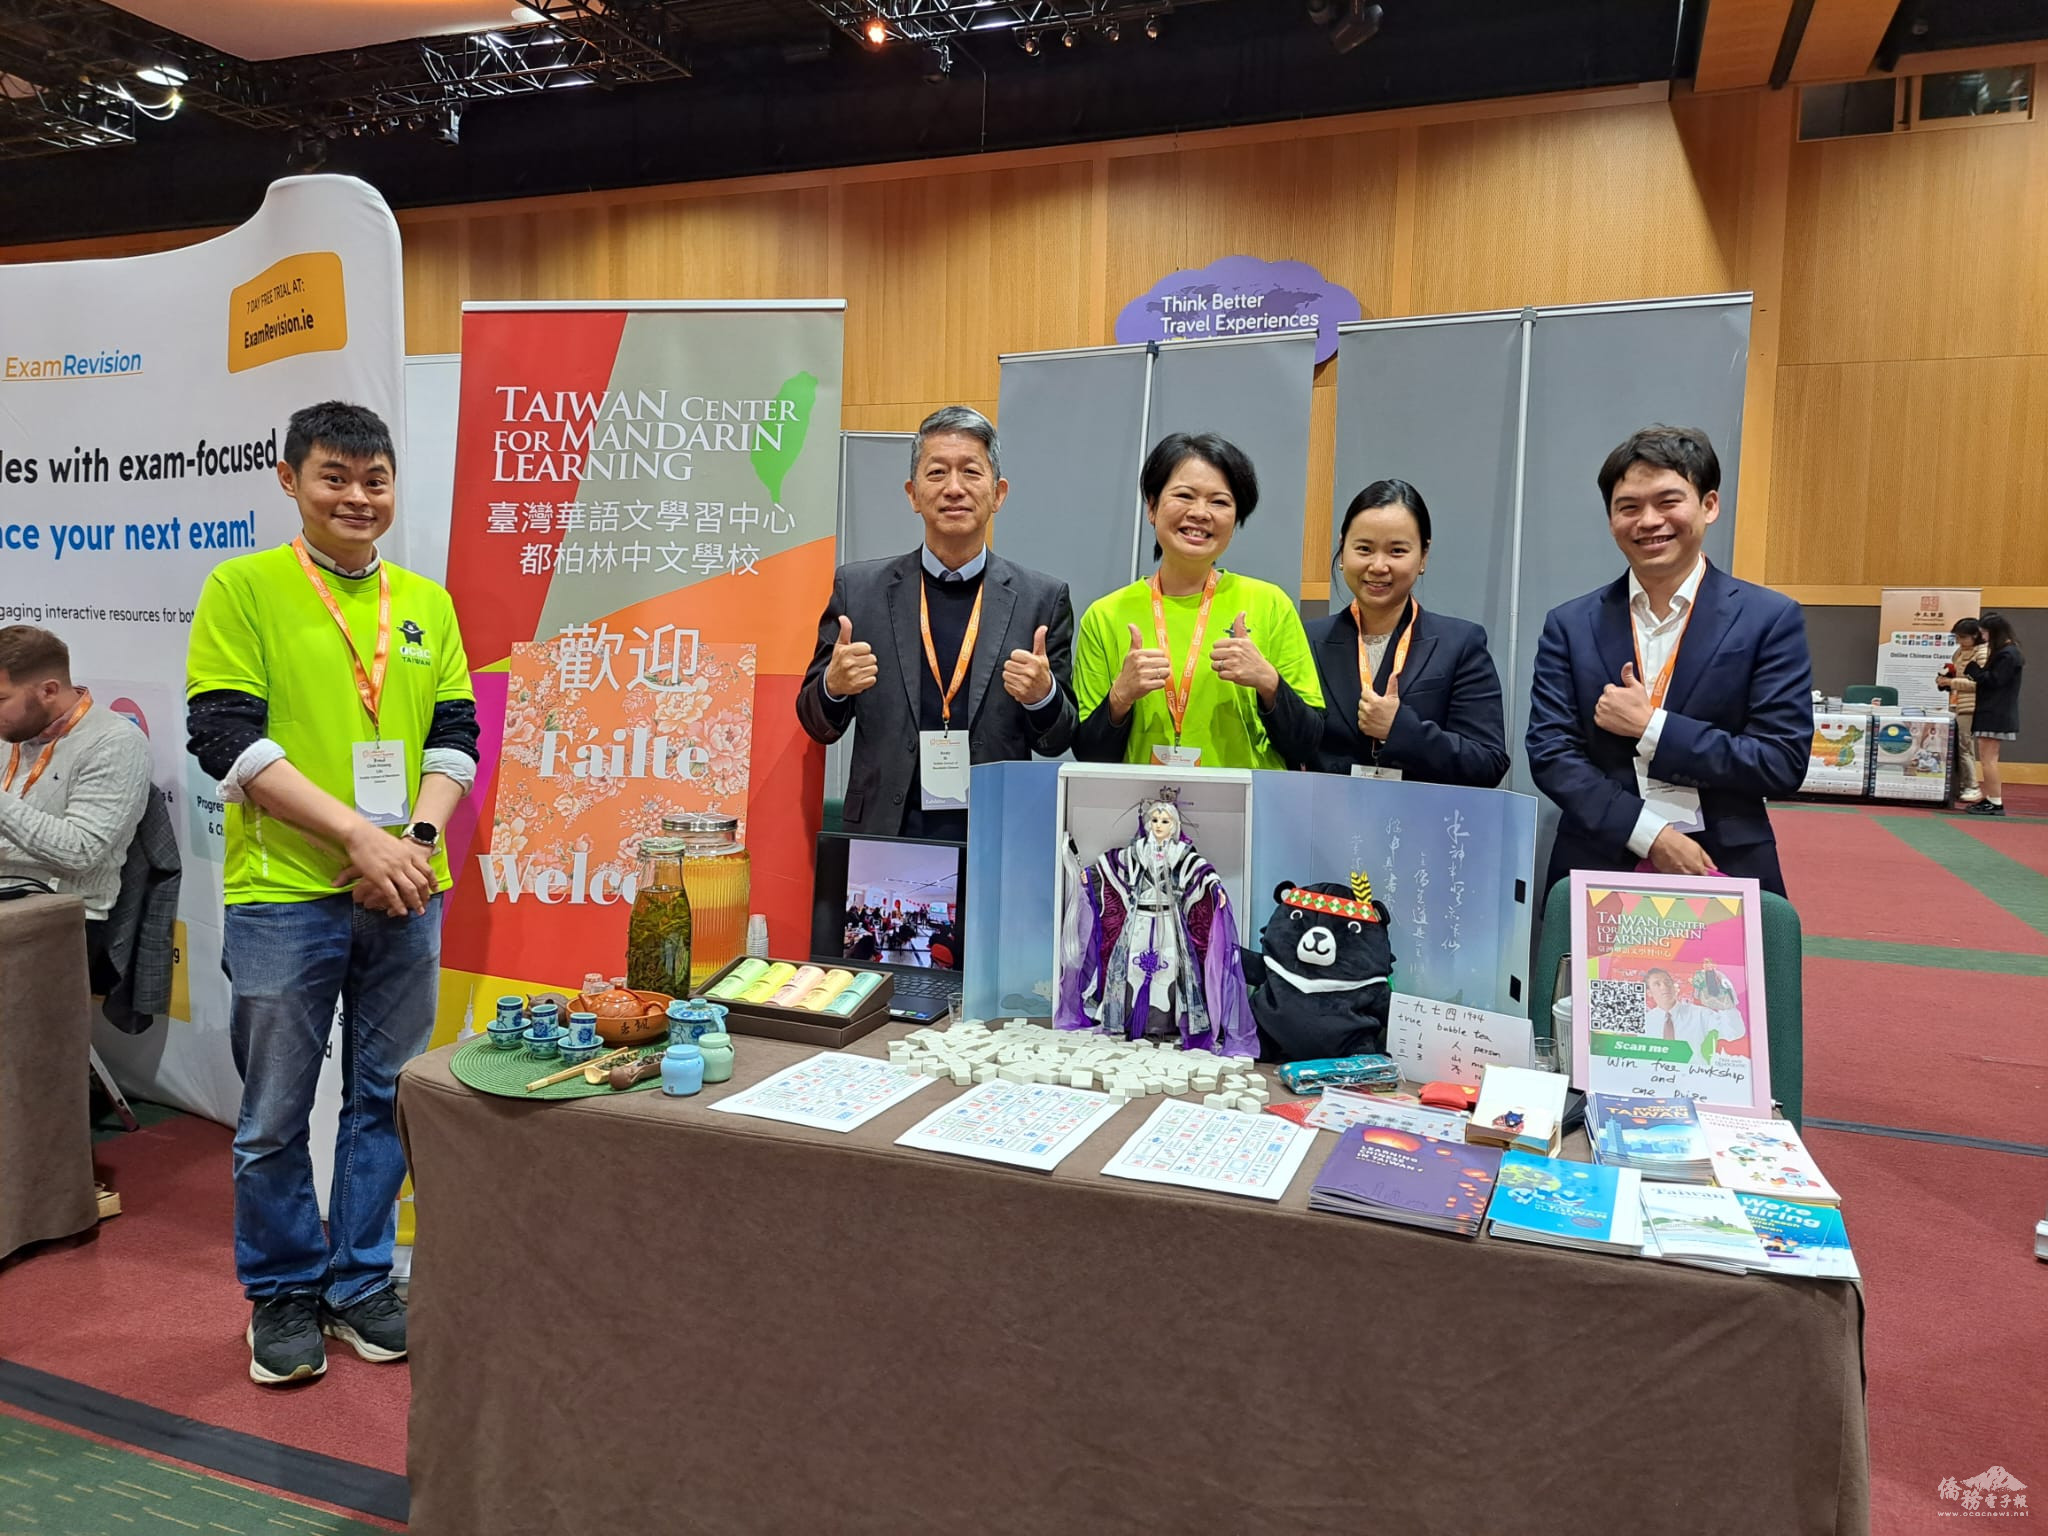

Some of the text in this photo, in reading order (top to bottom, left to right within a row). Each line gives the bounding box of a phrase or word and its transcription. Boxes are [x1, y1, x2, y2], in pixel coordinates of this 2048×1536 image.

[250, 298, 260, 313] DAY
[261, 289, 273, 305] FREE
[273, 282, 291, 301] TRIAL
[292, 278, 305, 292] AT:
[1161, 293, 1264, 313] Think Better
[244, 308, 314, 349] ExamRevision.ie
[1160, 313, 1319, 334] Travel Experiences
[5, 351, 141, 379] ExamRevision
[495, 386, 668, 423] TAIWAN
[493, 421, 784, 453] FOR MANDARIN
[49, 446, 109, 483] with
[119, 428, 277, 482] exam-focused
[492, 449, 695, 482] LEARNING
[486, 500, 796, 535] 臺灣華語文學習中心
[50, 523, 115, 560] your
[126, 517, 181, 550] next
[189, 510, 255, 549] exam!
[519, 541, 761, 576] 都柏林中文學校
[45, 604, 106, 621] interactive
[109, 608, 160, 623] resources
[163, 608, 176, 622] for
[402, 657, 431, 666] TAIWAN
[557, 623, 699, 693] 歡迎
[537, 726, 709, 780] Fáilte
[1596, 911, 1659, 927] TAIWAN
[1597, 925, 1702, 939] FOR MANDARIN
[1598, 931, 1670, 947] LEARNING
[1437, 1023, 1467, 1036] bubble
[1474, 1030, 1492, 1042] tea
[1474, 1046, 1501, 1058] person
[1614, 1041, 1669, 1053] Scan me
[1607, 1056, 1638, 1068] Win
[1651, 1058, 1680, 1072] free
[1650, 1075, 1676, 1083] and
[1632, 1087, 1656, 1096] one
[1605, 1107, 1689, 1118] TAIWAN
[1361, 1145, 1418, 1163] LEARNING
[1372, 1155, 1415, 1170] TAIWAN
